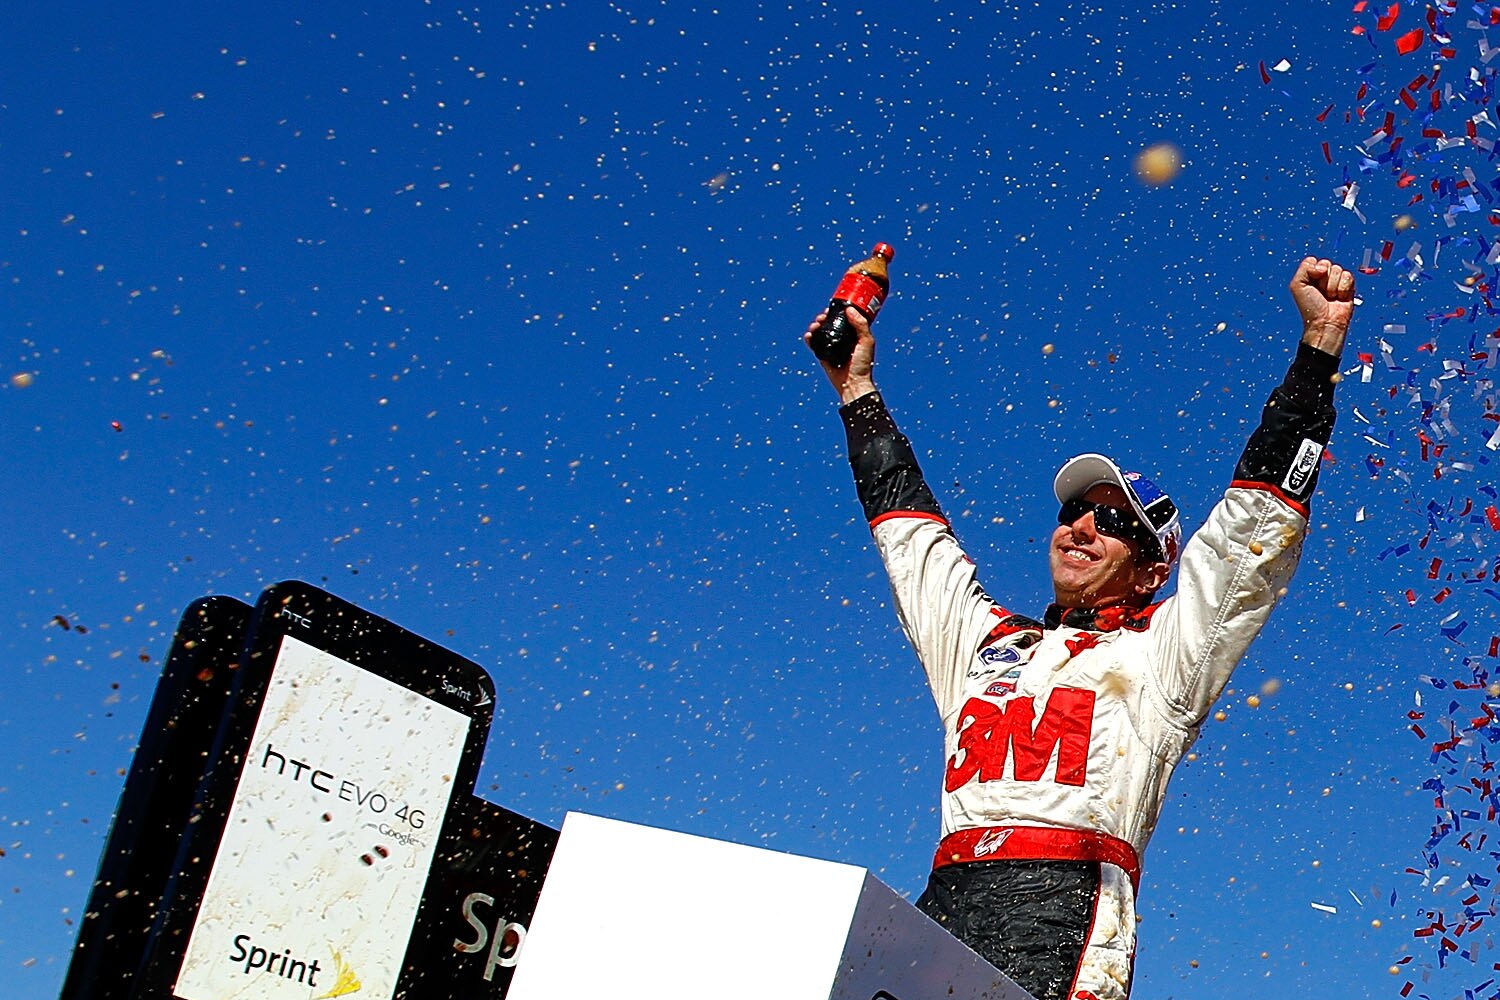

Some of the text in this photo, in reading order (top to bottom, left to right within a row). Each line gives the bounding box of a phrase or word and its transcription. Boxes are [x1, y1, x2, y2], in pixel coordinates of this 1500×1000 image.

[440, 679, 472, 702] Sprint
[945, 687, 1096, 792] 3M
[338, 780, 388, 813] EVO
[394, 805, 427, 830] 4G
[378, 823, 416, 846] Google
[229, 934, 321, 988] Sprint
